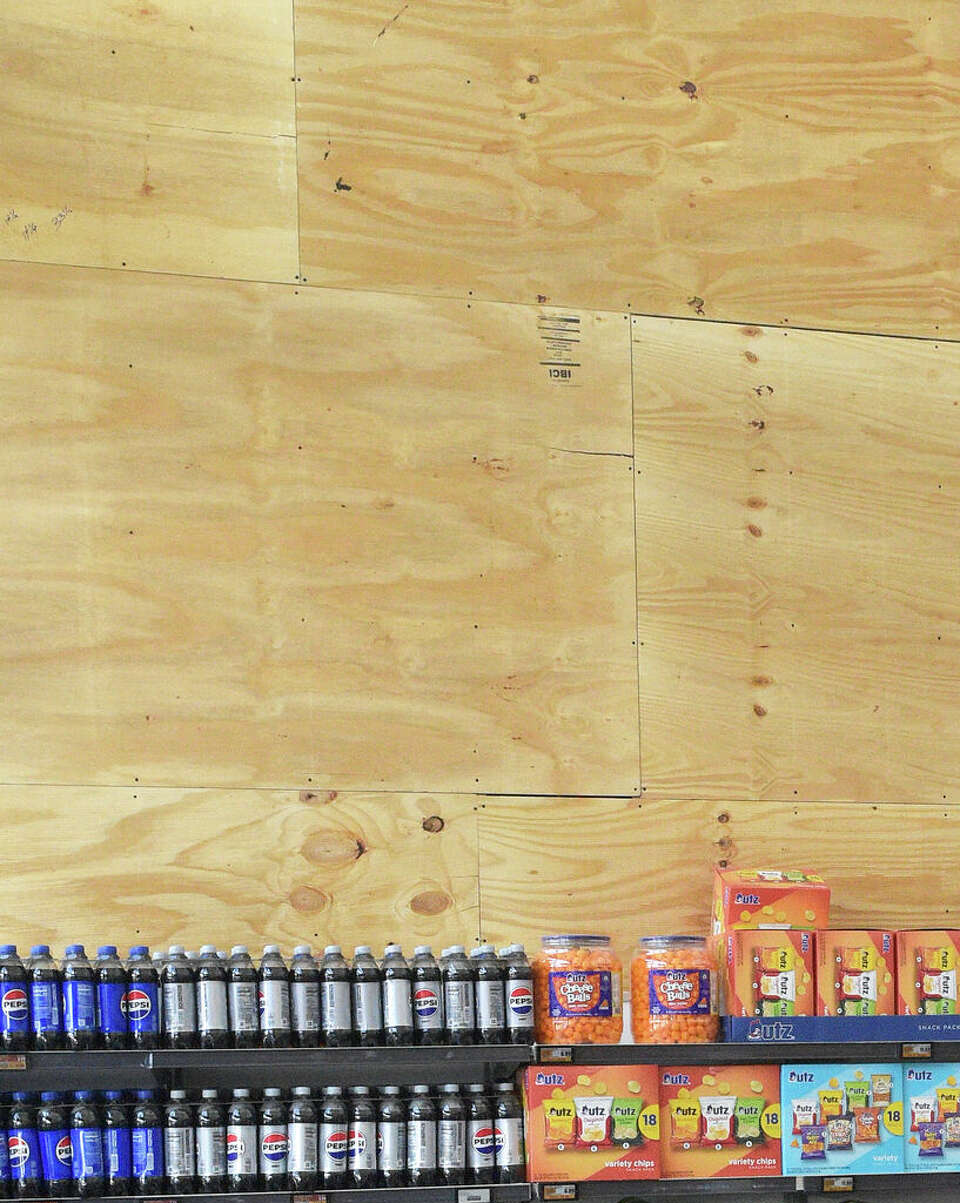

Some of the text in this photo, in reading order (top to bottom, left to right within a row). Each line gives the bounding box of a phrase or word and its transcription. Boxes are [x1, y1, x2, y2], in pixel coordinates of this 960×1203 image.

[642, 1114, 656, 1126] 18
[764, 1112, 778, 1124] 18
[887, 1110, 901, 1122] 18
[632, 1159, 655, 1168] chips
[756, 1157, 777, 1166] chips
